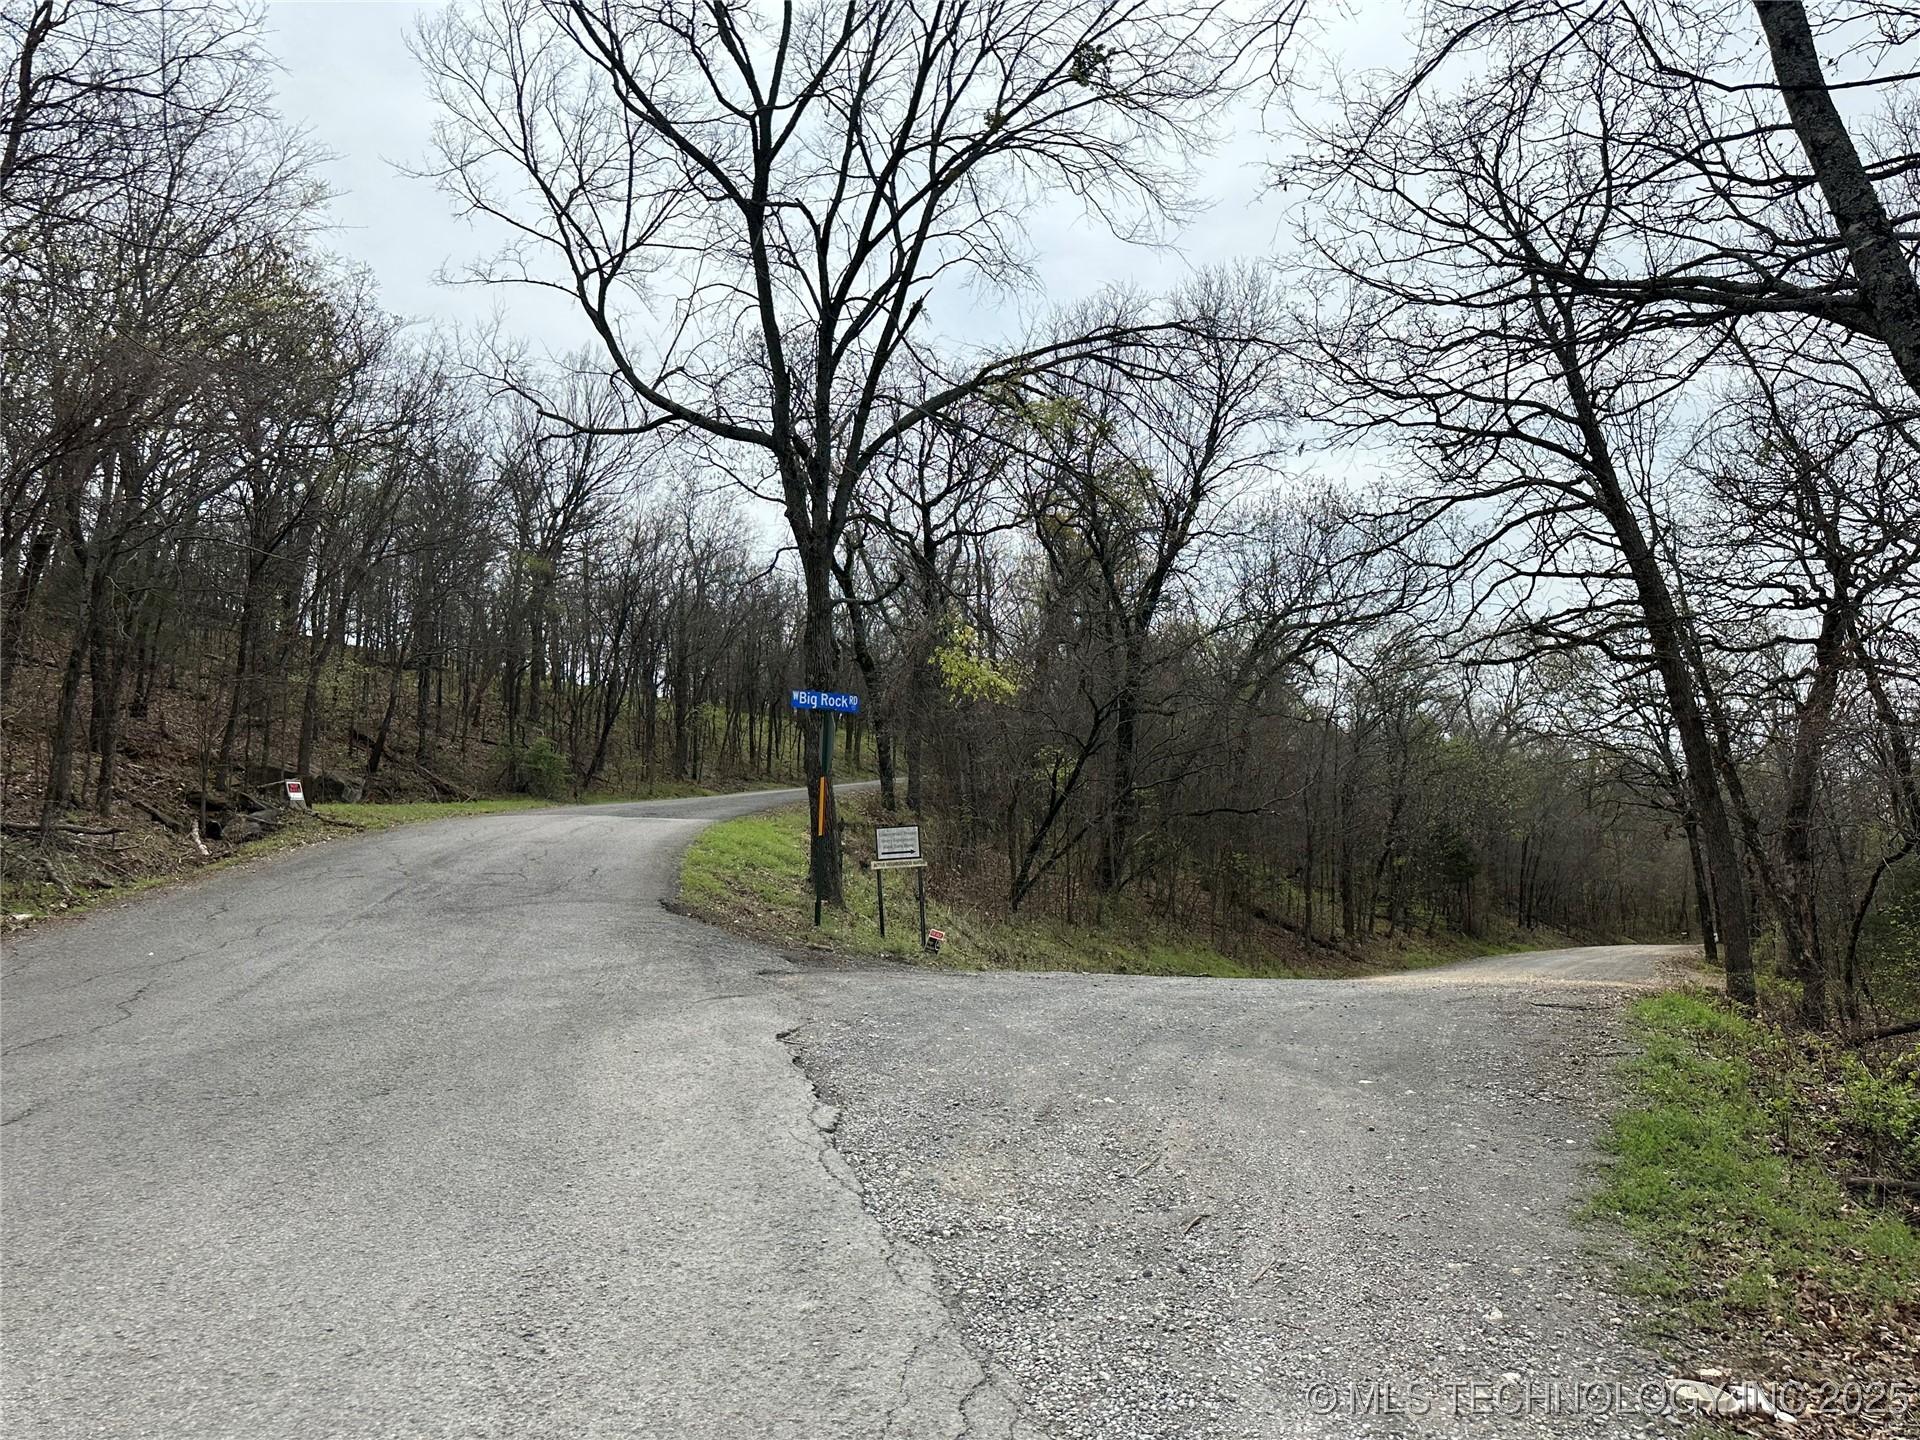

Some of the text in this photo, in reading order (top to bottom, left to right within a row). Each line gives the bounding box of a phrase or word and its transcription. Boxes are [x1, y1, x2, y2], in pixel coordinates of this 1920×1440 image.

[793, 691, 858, 709] W Big Rock RD
